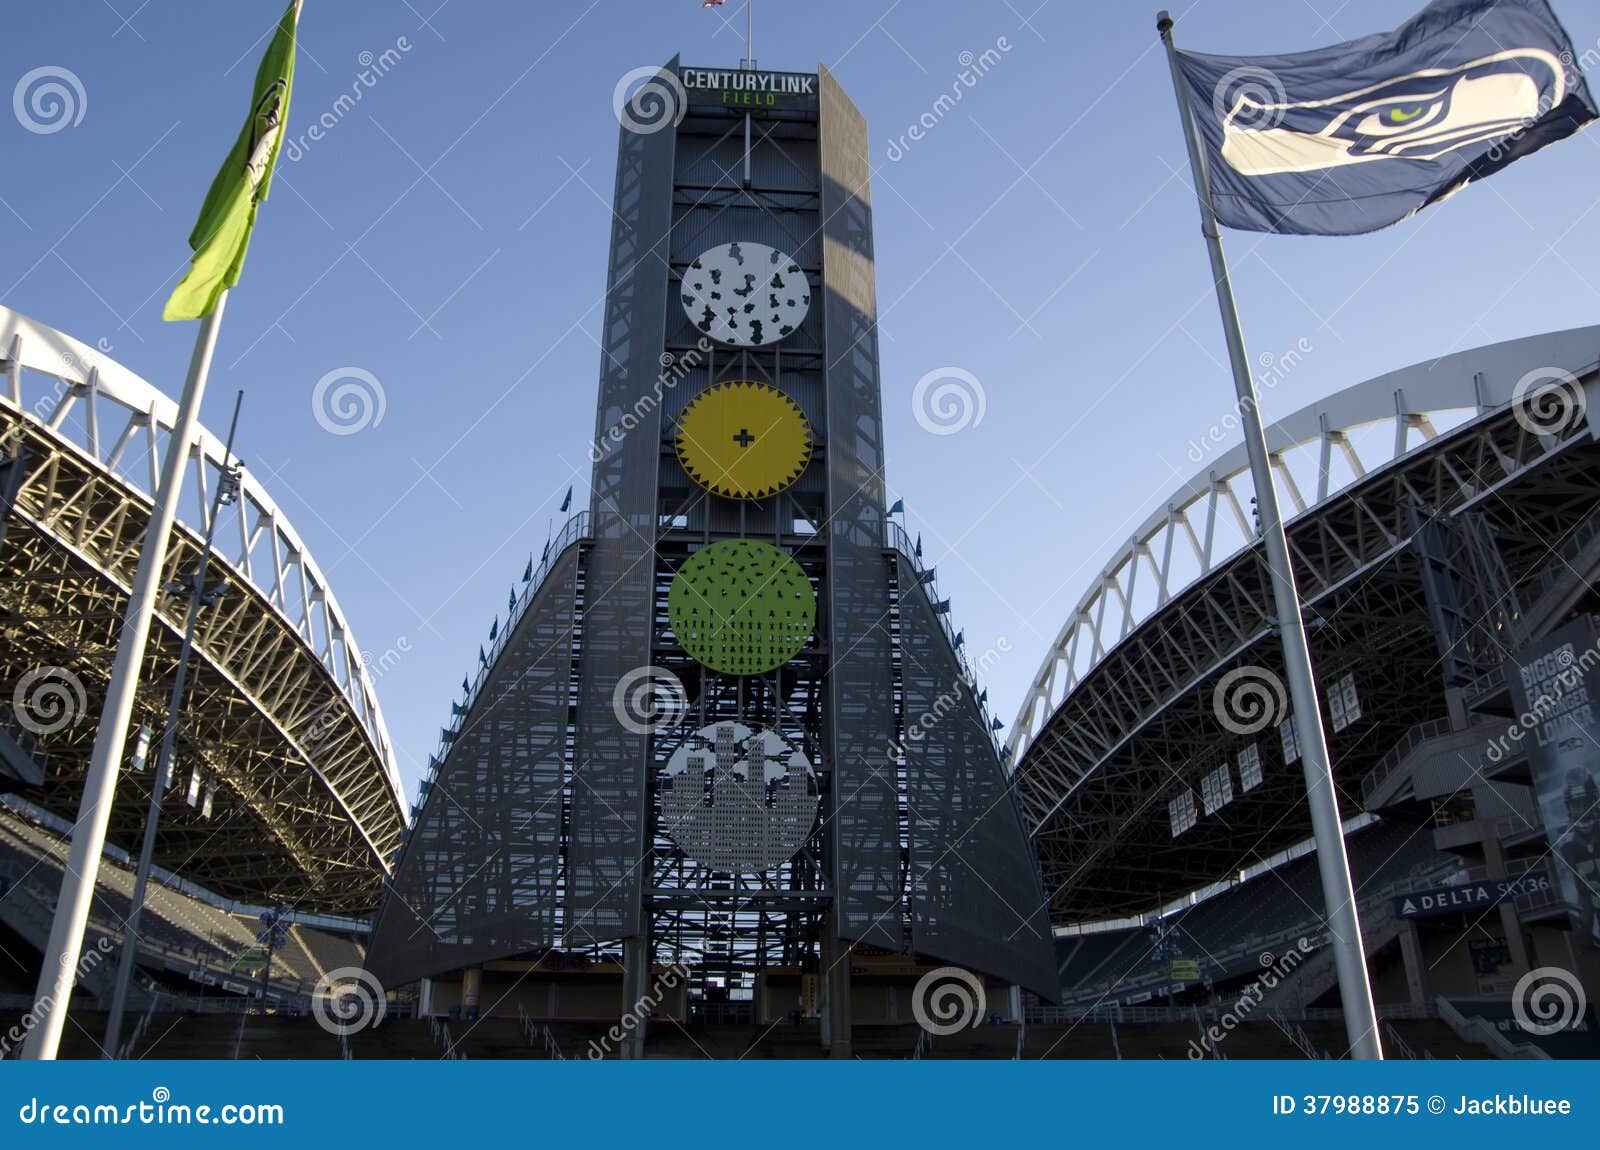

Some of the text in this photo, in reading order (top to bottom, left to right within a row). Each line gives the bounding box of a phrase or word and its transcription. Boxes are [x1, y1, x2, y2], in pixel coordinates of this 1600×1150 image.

[683, 69, 813, 94] CENTURYLINK
[722, 91, 776, 106] FIELD
[1421, 876, 1552, 910] DELTA SKY36
